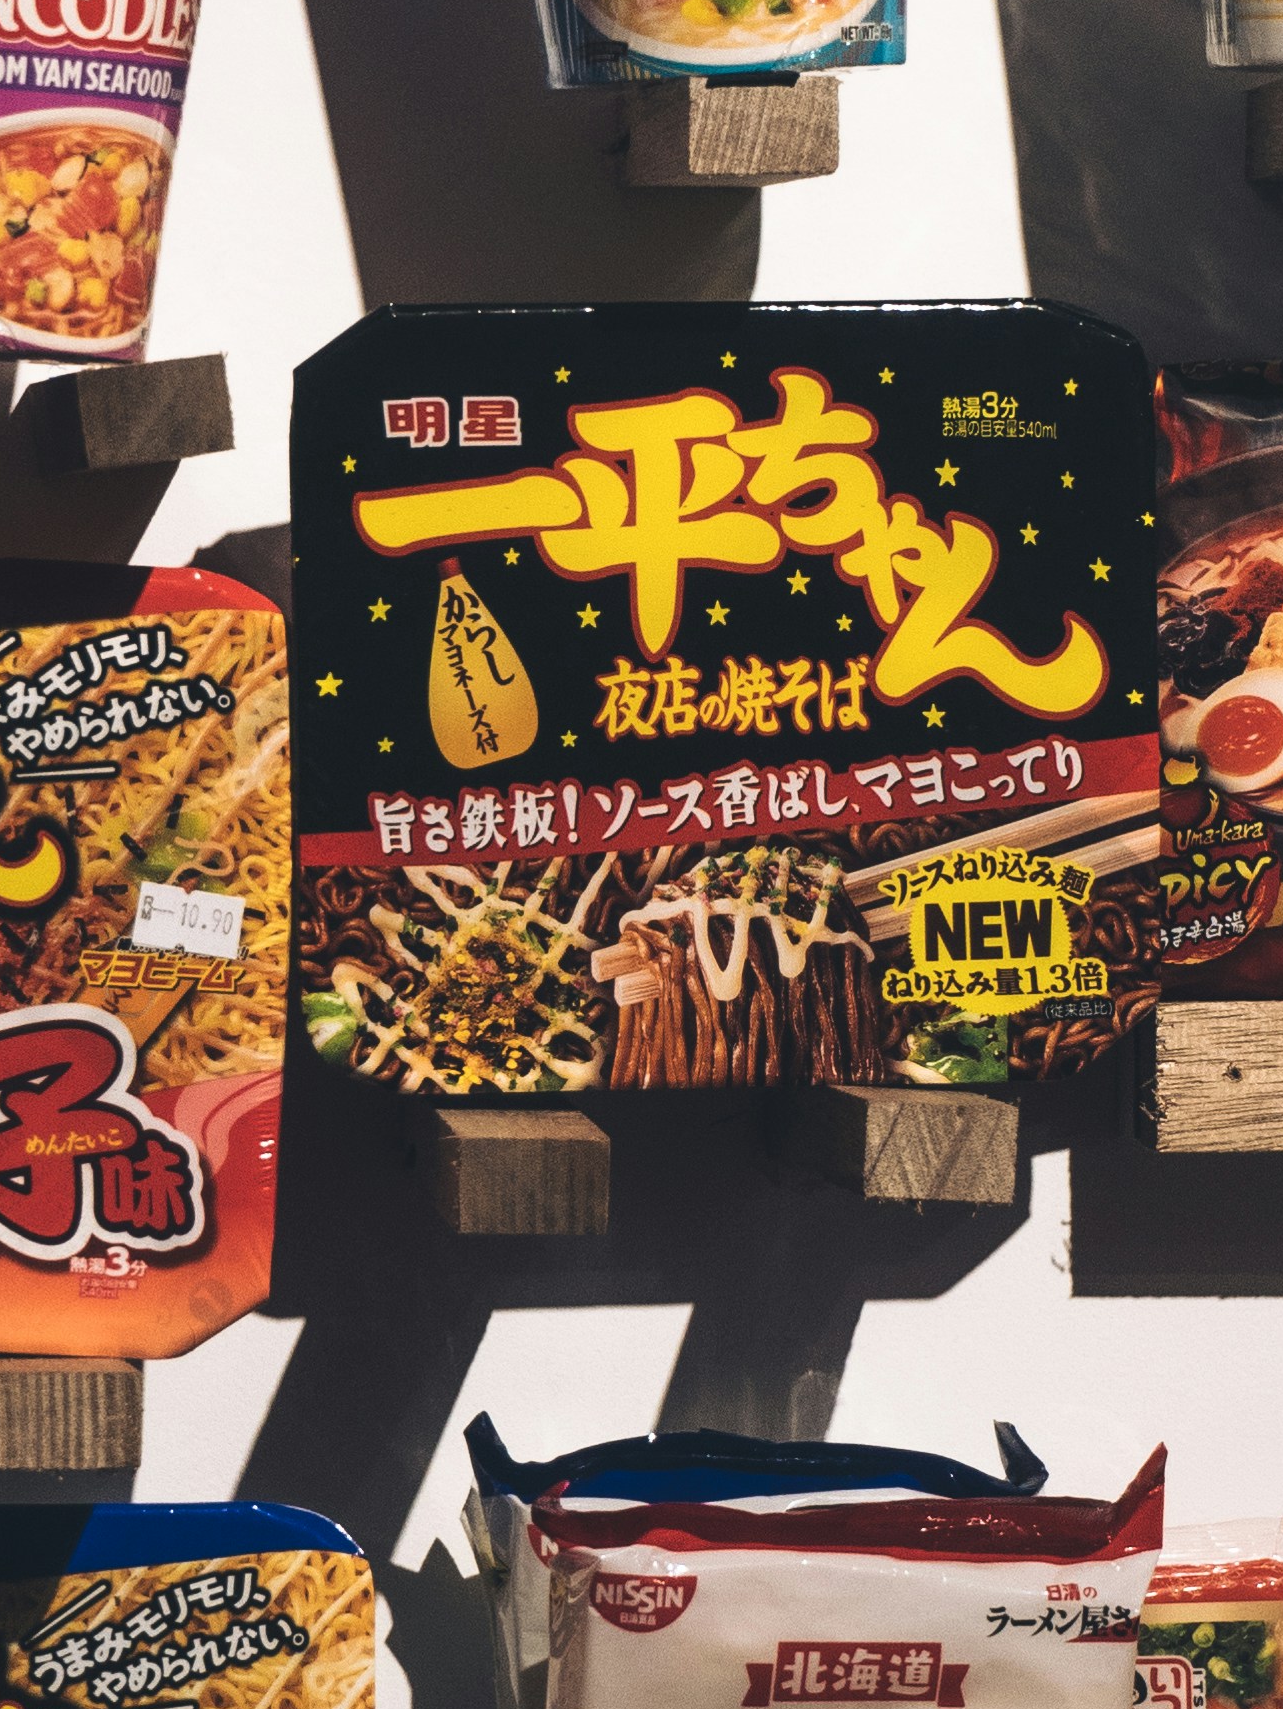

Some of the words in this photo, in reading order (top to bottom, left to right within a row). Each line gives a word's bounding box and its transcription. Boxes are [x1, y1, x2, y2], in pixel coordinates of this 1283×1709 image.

[32, 57, 83, 89] YAM
[85, 60, 173, 99] SEAFOOD
[382, 396, 522, 449] 明星
[942, 392, 1020, 420] 熱湯3分
[356, 367, 1110, 721] 一平ちゃん
[596, 658, 872, 738] 夜店の焼そば
[921, 898, 1055, 965] NEW
[882, 961, 1108, 1001] ねり込み量1.3倍
[22, 1126, 125, 1159] めんたいこ
[593, 1579, 685, 1613] NISSIN
[780, 1647, 936, 1697] 北海道
